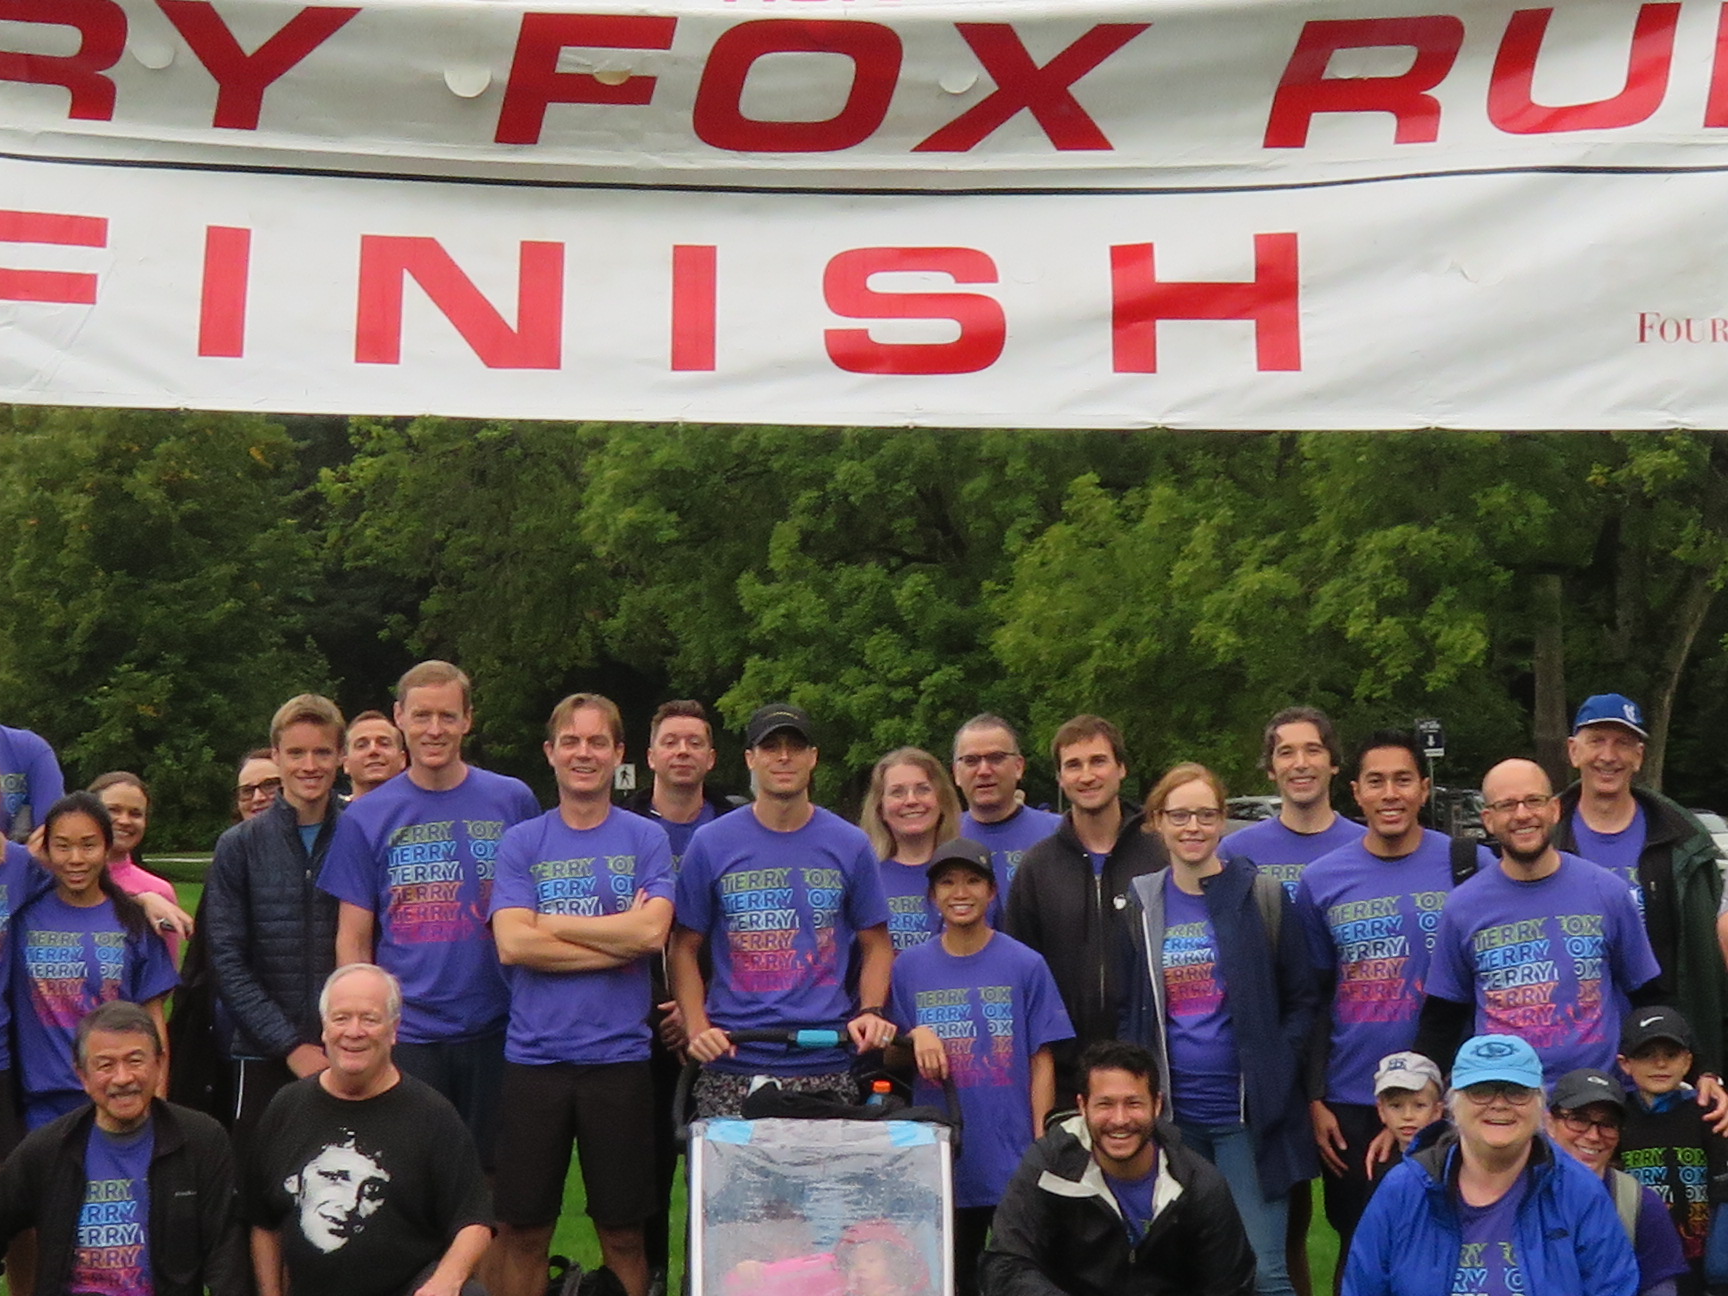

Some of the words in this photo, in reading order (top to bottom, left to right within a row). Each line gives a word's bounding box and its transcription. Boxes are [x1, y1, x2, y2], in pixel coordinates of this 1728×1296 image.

[495, 12, 1149, 153] FOX
[462, 819, 504, 840] OX
[387, 860, 460, 886] TERRY
[720, 867, 793, 894] TERRY
[799, 867, 844, 889] OX
[537, 876, 597, 902] ERRY
[721, 888, 793, 913] TERRY
[805, 888, 843, 909] OX
[538, 895, 600, 917] ERRY
[886, 895, 925, 914] RRY
[1327, 894, 1403, 926] TERRY
[887, 912, 928, 931] RRY
[1331, 914, 1403, 945] ERRY
[25, 929, 85, 948] ERRY
[91, 930, 128, 948] OX
[889, 931, 931, 950] RRY
[1163, 935, 1210, 953] ERRY
[1473, 916, 1549, 953] TERRY
[1554, 914, 1605, 937] OX
[94, 946, 125, 964] OX
[1162, 948, 1213, 969] ERRY
[1337, 935, 1407, 963] ERRY
[1474, 938, 1551, 972] TERRY
[1562, 935, 1606, 958] OX
[26, 961, 87, 979] ERRY
[1163, 962, 1216, 985] ERRY
[1340, 957, 1411, 981] ERRY
[915, 987, 971, 1008] TERRY
[976, 985, 1013, 1004] OX
[1484, 981, 1559, 1010] ERRY
[915, 1003, 972, 1024] TERRY
[981, 1002, 1014, 1019] OX
[928, 1020, 974, 1040] RRY
[1672, 1146, 1709, 1166] OX
[1677, 1165, 1709, 1185] OX
[84, 1178, 135, 1204] RRY
[79, 1200, 138, 1226] RRY
[76, 1222, 141, 1248] ERRY
[74, 1244, 145, 1270] ERRY
